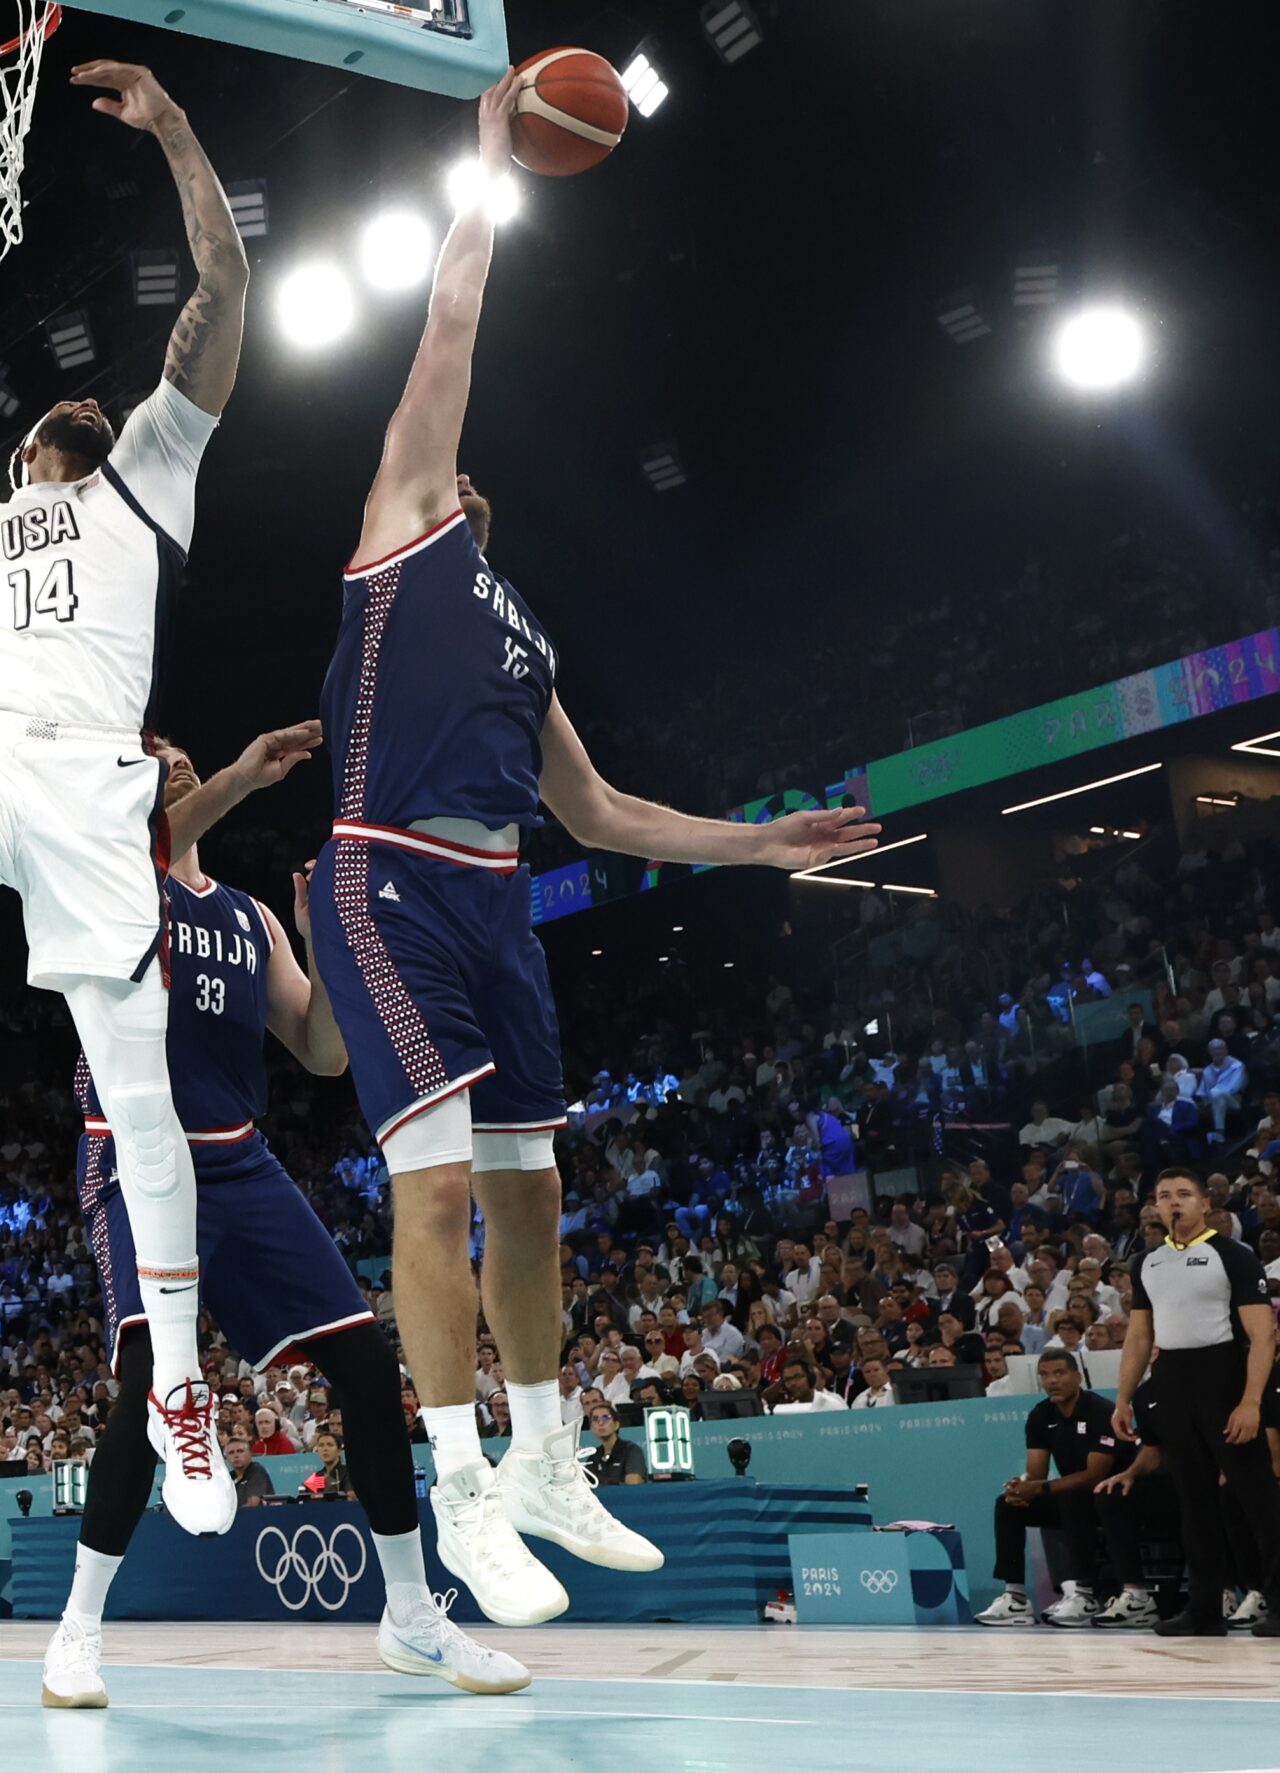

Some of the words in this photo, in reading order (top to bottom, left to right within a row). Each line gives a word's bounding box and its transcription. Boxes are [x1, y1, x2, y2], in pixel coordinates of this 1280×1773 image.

[1, 500, 81, 561] USA
[7, 558, 79, 631] 14
[501, 636, 530, 680] 15
[1044, 685, 1154, 744] PARS
[543, 867, 608, 909] 2024
[195, 973, 226, 1016] 33
[802, 1567, 839, 1581] PARIS
[804, 1582, 841, 1596] 2024
